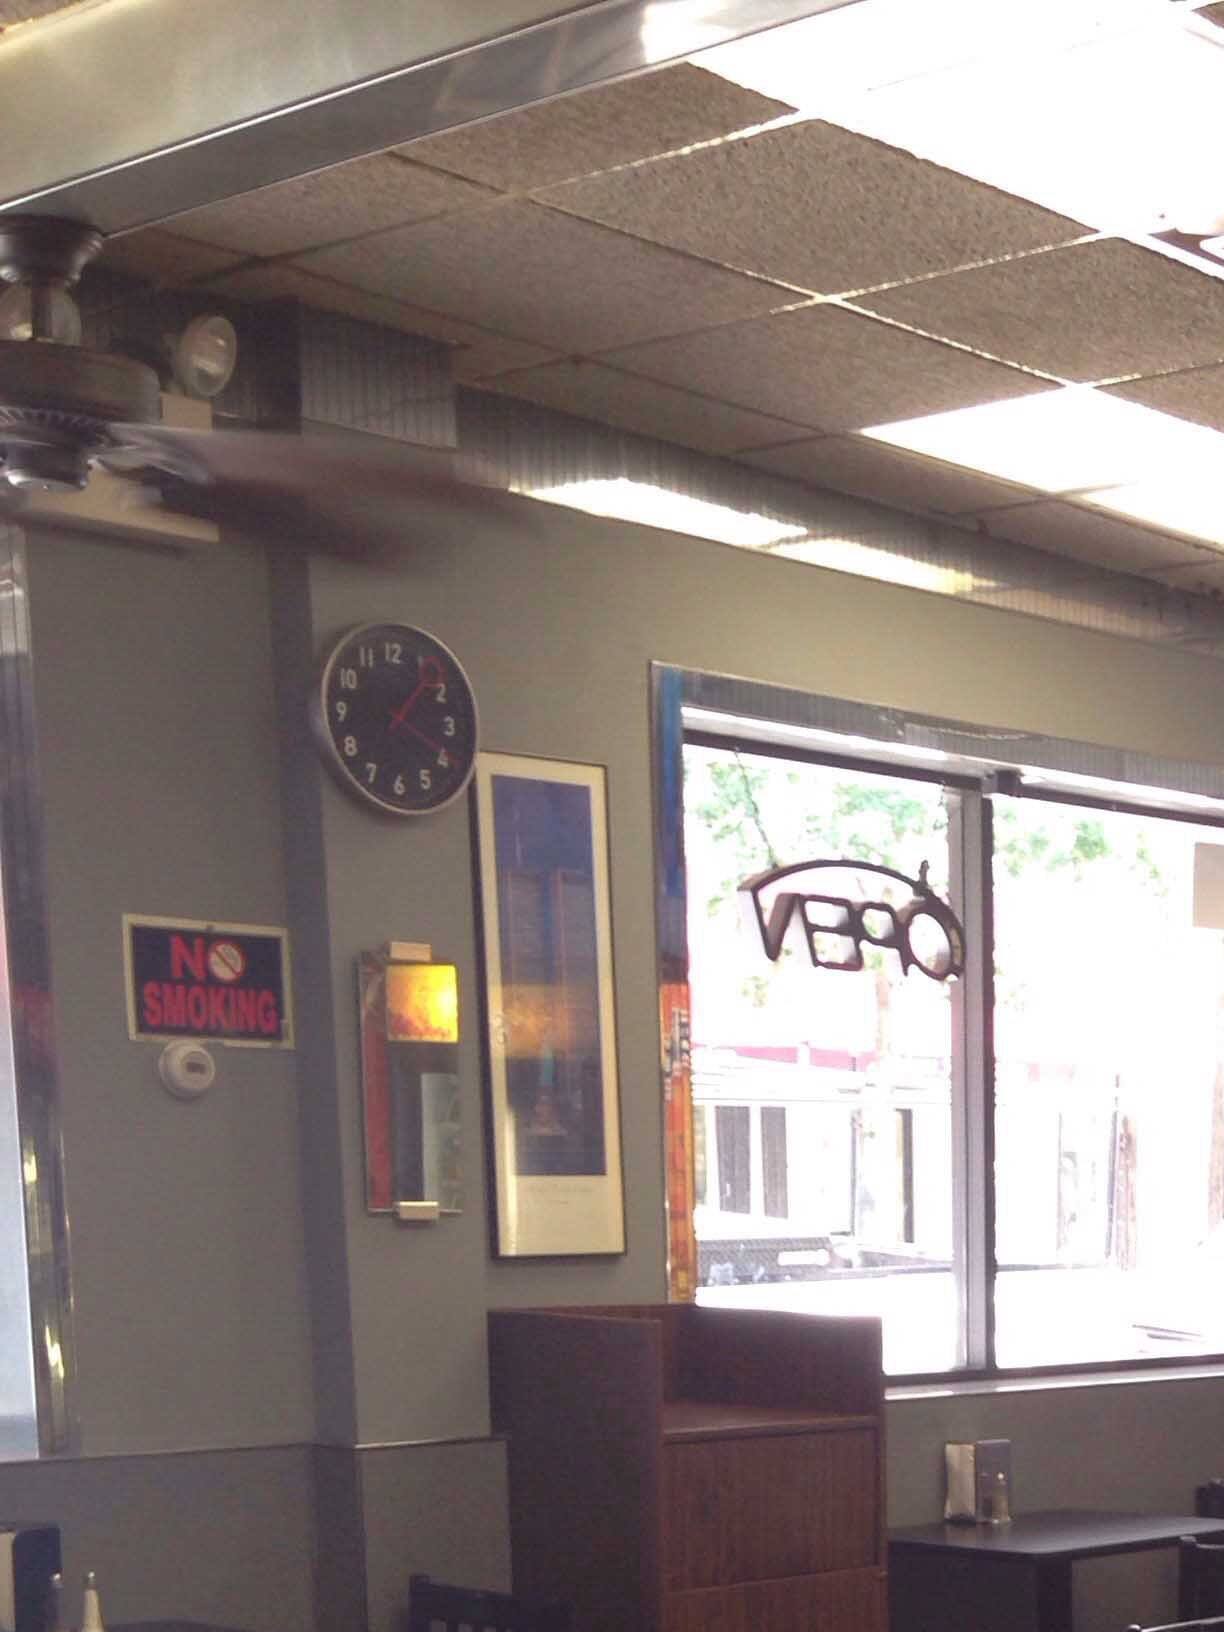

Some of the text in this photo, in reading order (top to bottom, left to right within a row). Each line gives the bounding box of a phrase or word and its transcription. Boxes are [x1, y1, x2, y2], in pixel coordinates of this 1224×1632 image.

[360, 647, 373, 668] 11
[386, 643, 402, 665] 12
[341, 668, 357, 689] 10
[436, 683, 446, 703] 2
[336, 701, 347, 722] 9
[444, 716, 455, 736] 3
[344, 735, 357, 757] 8
[437, 749, 449, 768] 4
[366, 763, 377, 783] 7
[420, 769, 431, 790] 5
[394, 775, 405, 795] 6
[143, 980, 280, 1034] SMOKING
